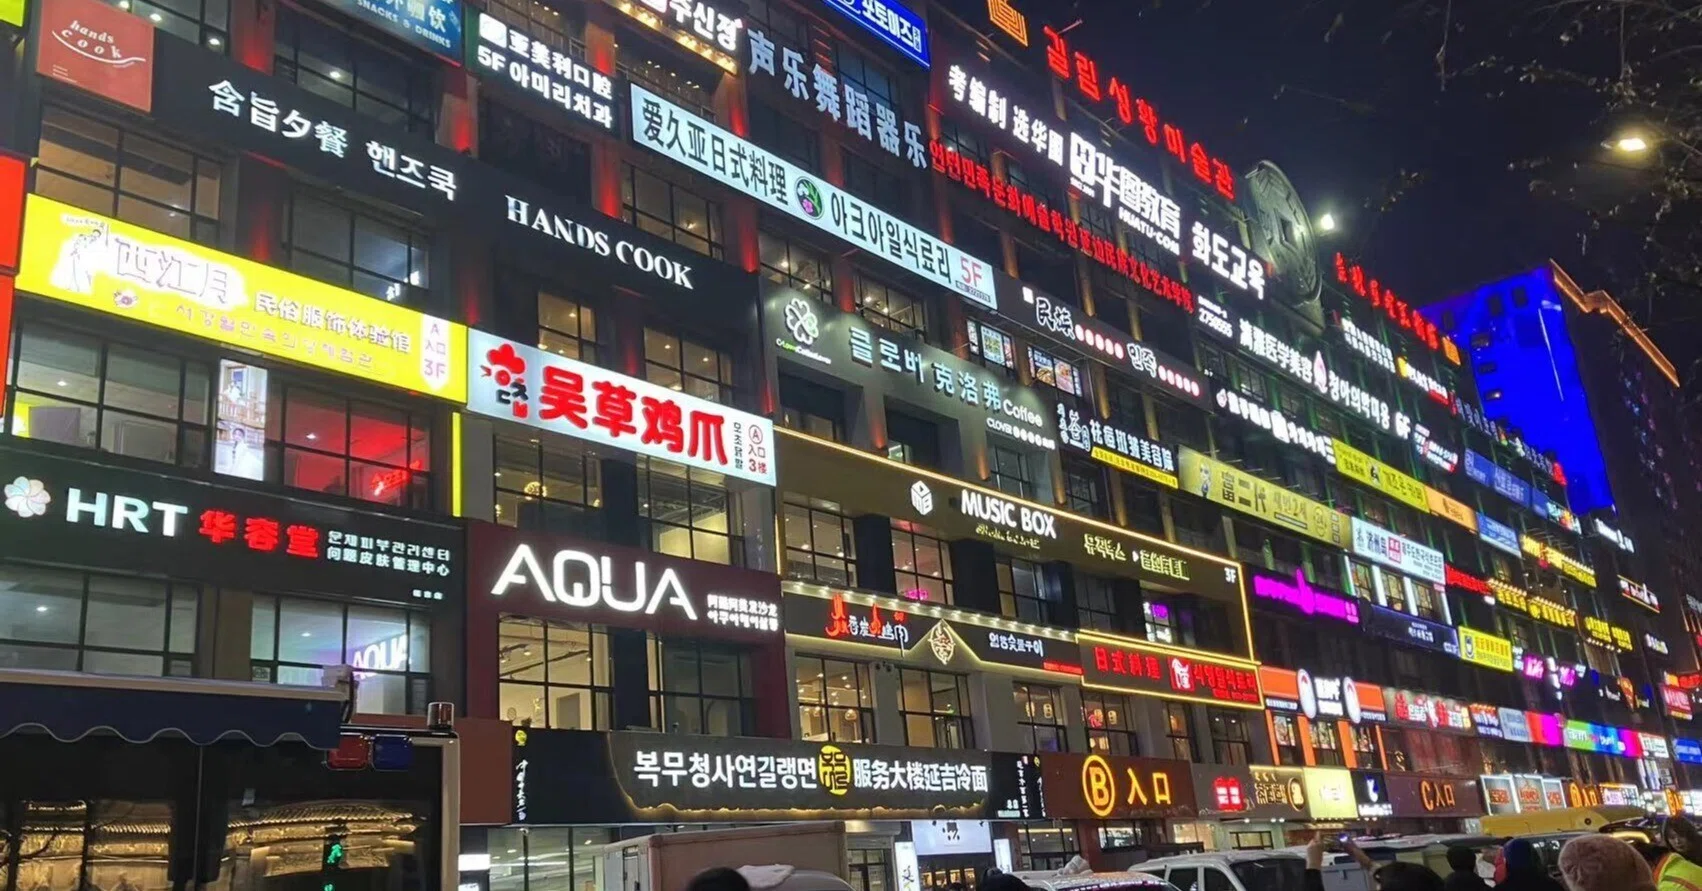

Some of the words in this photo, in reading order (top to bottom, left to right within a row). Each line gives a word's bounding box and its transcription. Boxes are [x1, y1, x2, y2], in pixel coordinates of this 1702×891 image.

[61, 29, 122, 58] cook
[69, 20, 115, 44] hands
[415, 24, 451, 49] DRINKS
[477, 45, 505, 72] 5F
[508, 28, 613, 100] 亚美利口腔
[747, 28, 928, 169] 声乐舞蹈器乐
[949, 65, 1006, 130] 考编制
[208, 79, 349, 158] 含旨夕餐
[365, 140, 457, 201] 핸즈쿡
[642, 97, 788, 206] 爱久亚日式料理
[831, 192, 951, 283] 아크아일식료리
[1095, 152, 1180, 240] 华图教育
[505, 194, 610, 257] HANDS
[616, 240, 693, 290] COOK
[959, 255, 982, 288] 5F
[430, 322, 440, 335] A
[1036, 297, 1076, 341] 民族
[424, 358, 446, 379] 3F
[425, 340, 447, 356] 入口
[932, 361, 1001, 411] 克洛弗
[1003, 398, 1043, 427] Coffee
[539, 365, 728, 467] 吴草鸡爪
[748, 444, 766, 458] 入口
[66, 487, 188, 537] HRT
[1222, 471, 1267, 513] 富二代
[199, 508, 319, 559] 华容堂
[961, 489, 1017, 528] MUSIC
[1020, 504, 1057, 540] BOX
[327, 545, 450, 577] 问题皮肤管理中心
[491, 543, 698, 620] AQUA
[1224, 566, 1237, 584] 3F
[1094, 646, 1161, 679] 日式料理
[633, 750, 817, 788] 복무청사연길랭면
[853, 757, 989, 793] 服务大楼延吉冷面
[1127, 767, 1172, 806] 入口
